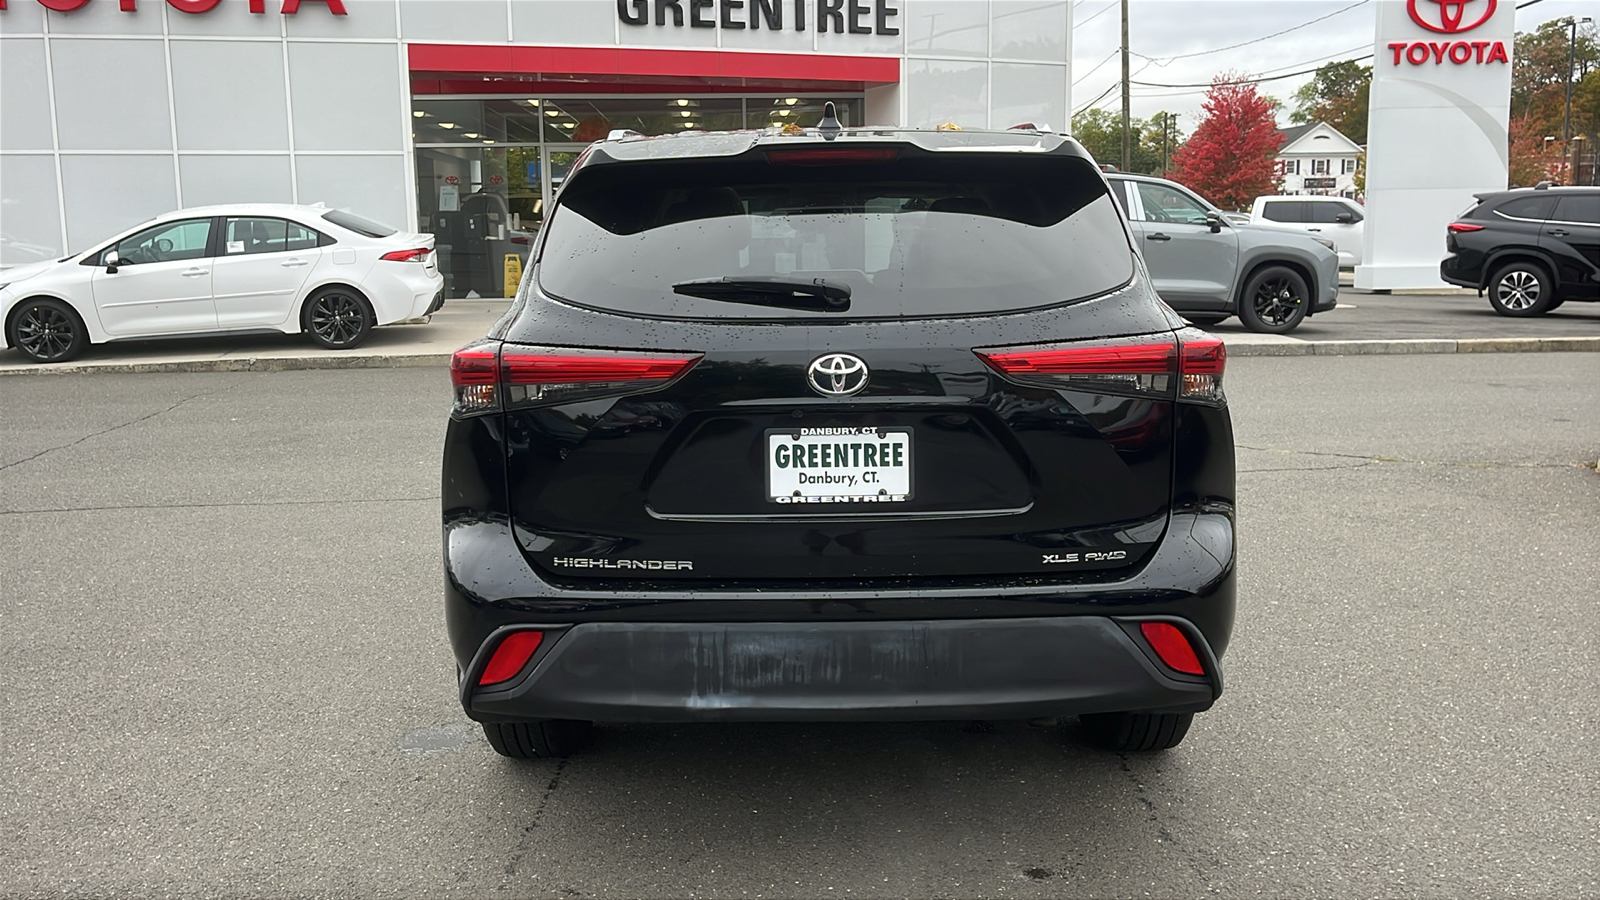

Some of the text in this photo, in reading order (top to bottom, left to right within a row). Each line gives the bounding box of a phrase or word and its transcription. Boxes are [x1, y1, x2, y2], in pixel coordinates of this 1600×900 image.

[1388, 41, 1509, 66] TOYOTA
[801, 426, 878, 436] DANBURY, CT
[775, 443, 903, 469] GREENTREE
[799, 471, 880, 487] Danbury, CT.
[775, 495, 906, 504] GREENTREE
[553, 557, 693, 570] HIGHLANDER
[1042, 550, 1127, 564] XLE AWD
